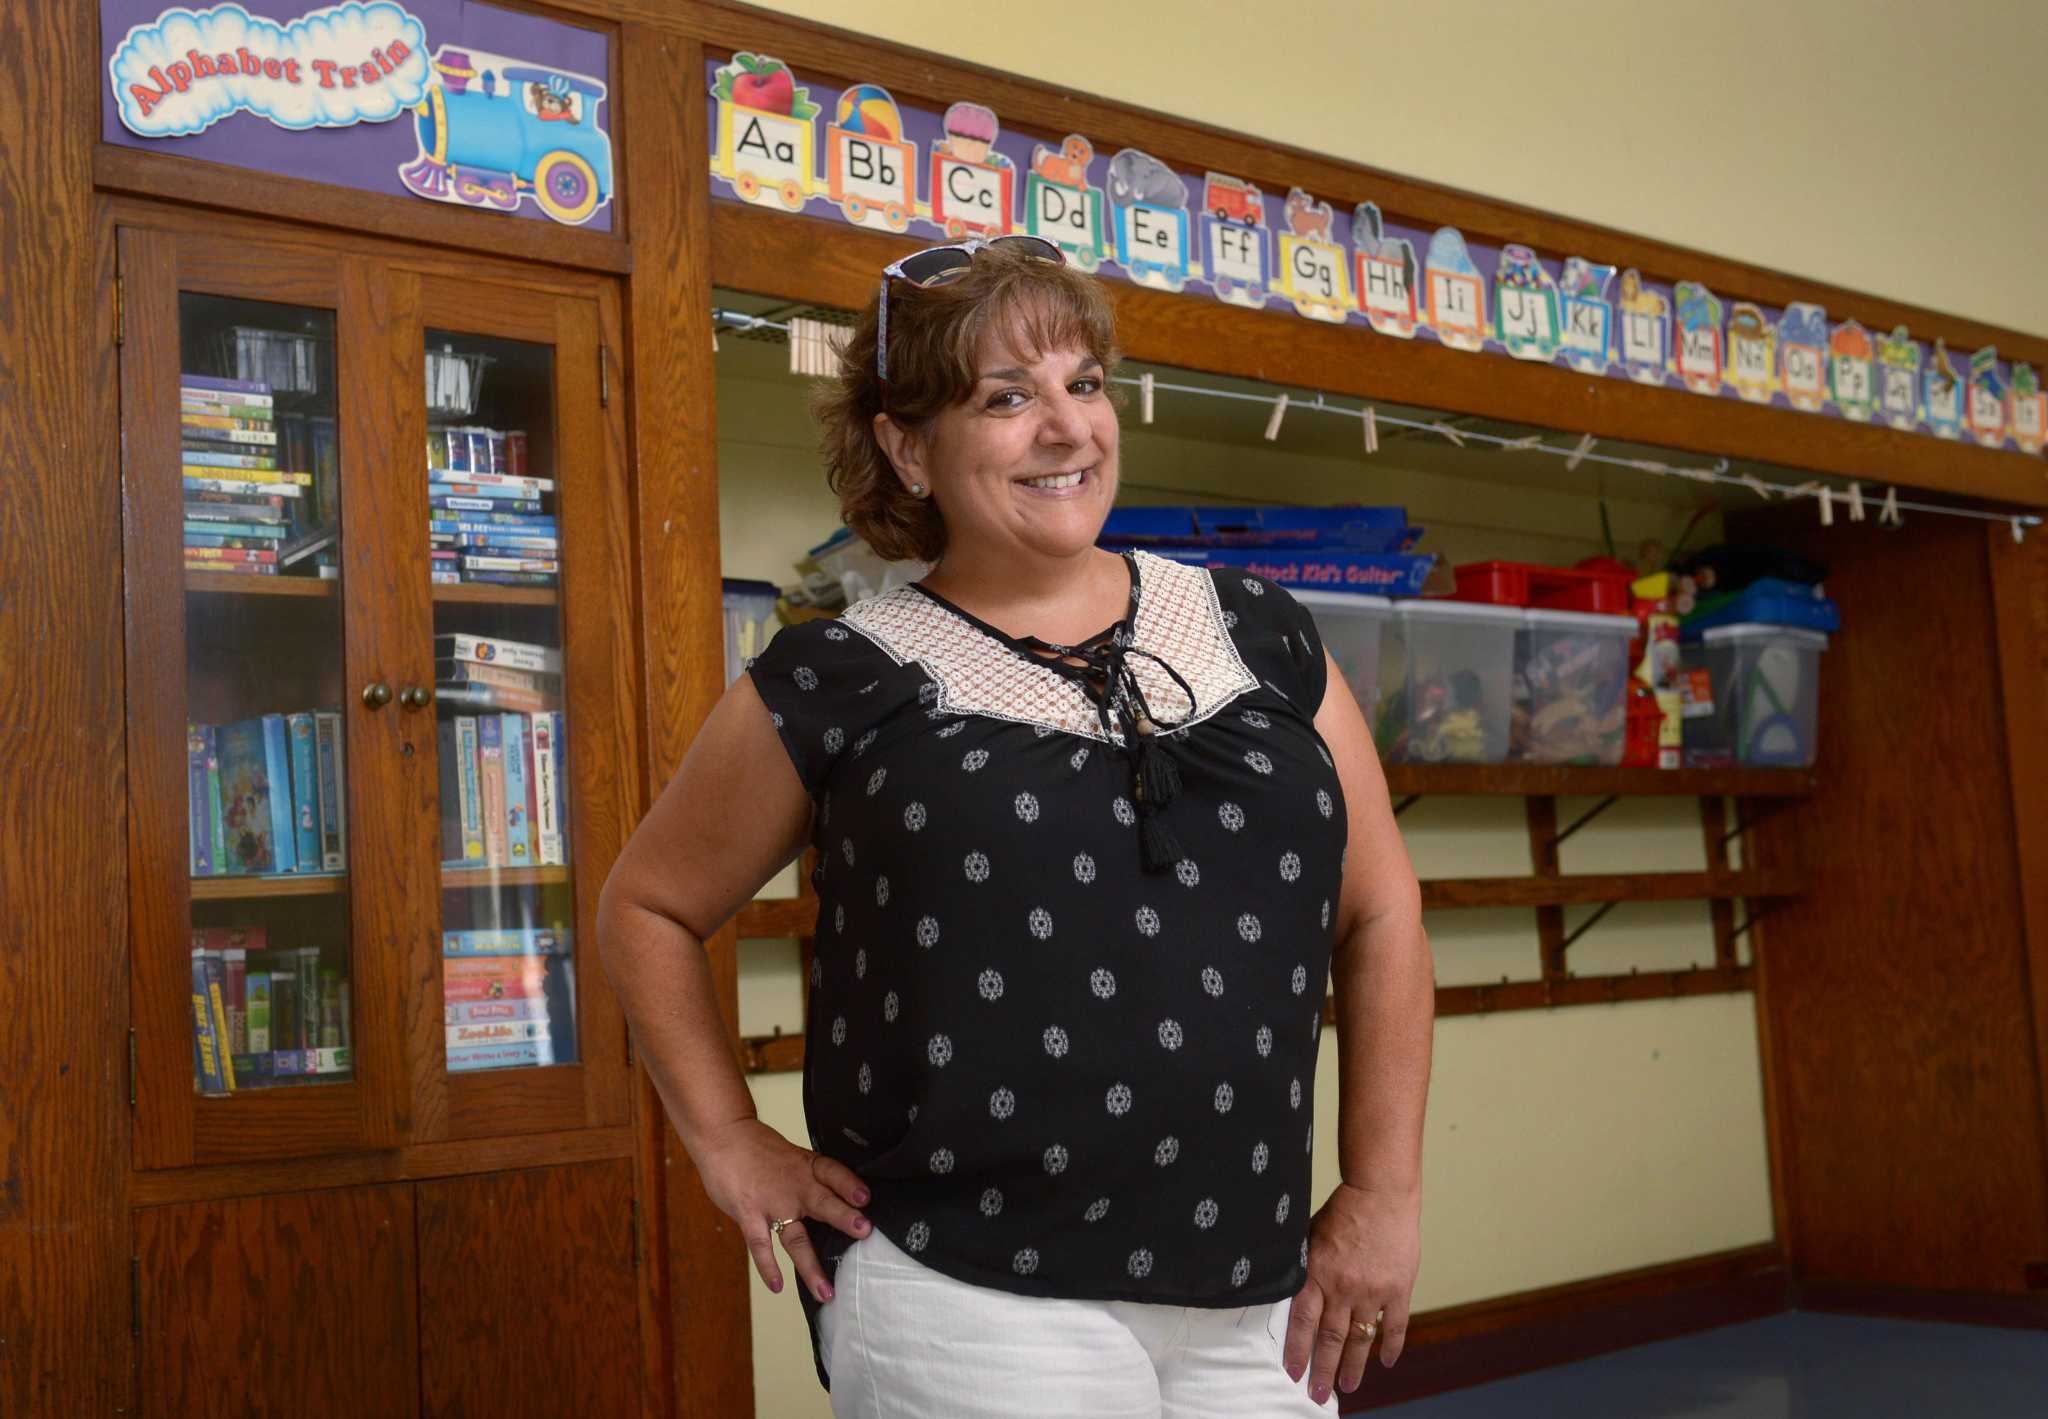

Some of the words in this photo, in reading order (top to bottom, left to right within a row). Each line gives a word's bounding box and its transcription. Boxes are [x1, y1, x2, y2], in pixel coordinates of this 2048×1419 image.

[129, 47, 303, 118] Alphabet
[312, 36, 413, 90] Train
[737, 116, 795, 164] Aa
[848, 140, 896, 187] Bb
[947, 165, 994, 209] Cc
[1041, 185, 1086, 230] Dd
[1133, 207, 1169, 249] Ee
[1220, 225, 1251, 264] Ff
[1293, 246, 1332, 298] Gg
[1367, 262, 1405, 300] Hh
[1443, 278, 1465, 312] Ii
[1508, 291, 1538, 337] Jj
[1572, 306, 1600, 337] Kk
[1303, 565, 1341, 583] Kid's
[1345, 567, 1403, 585] Guitar
